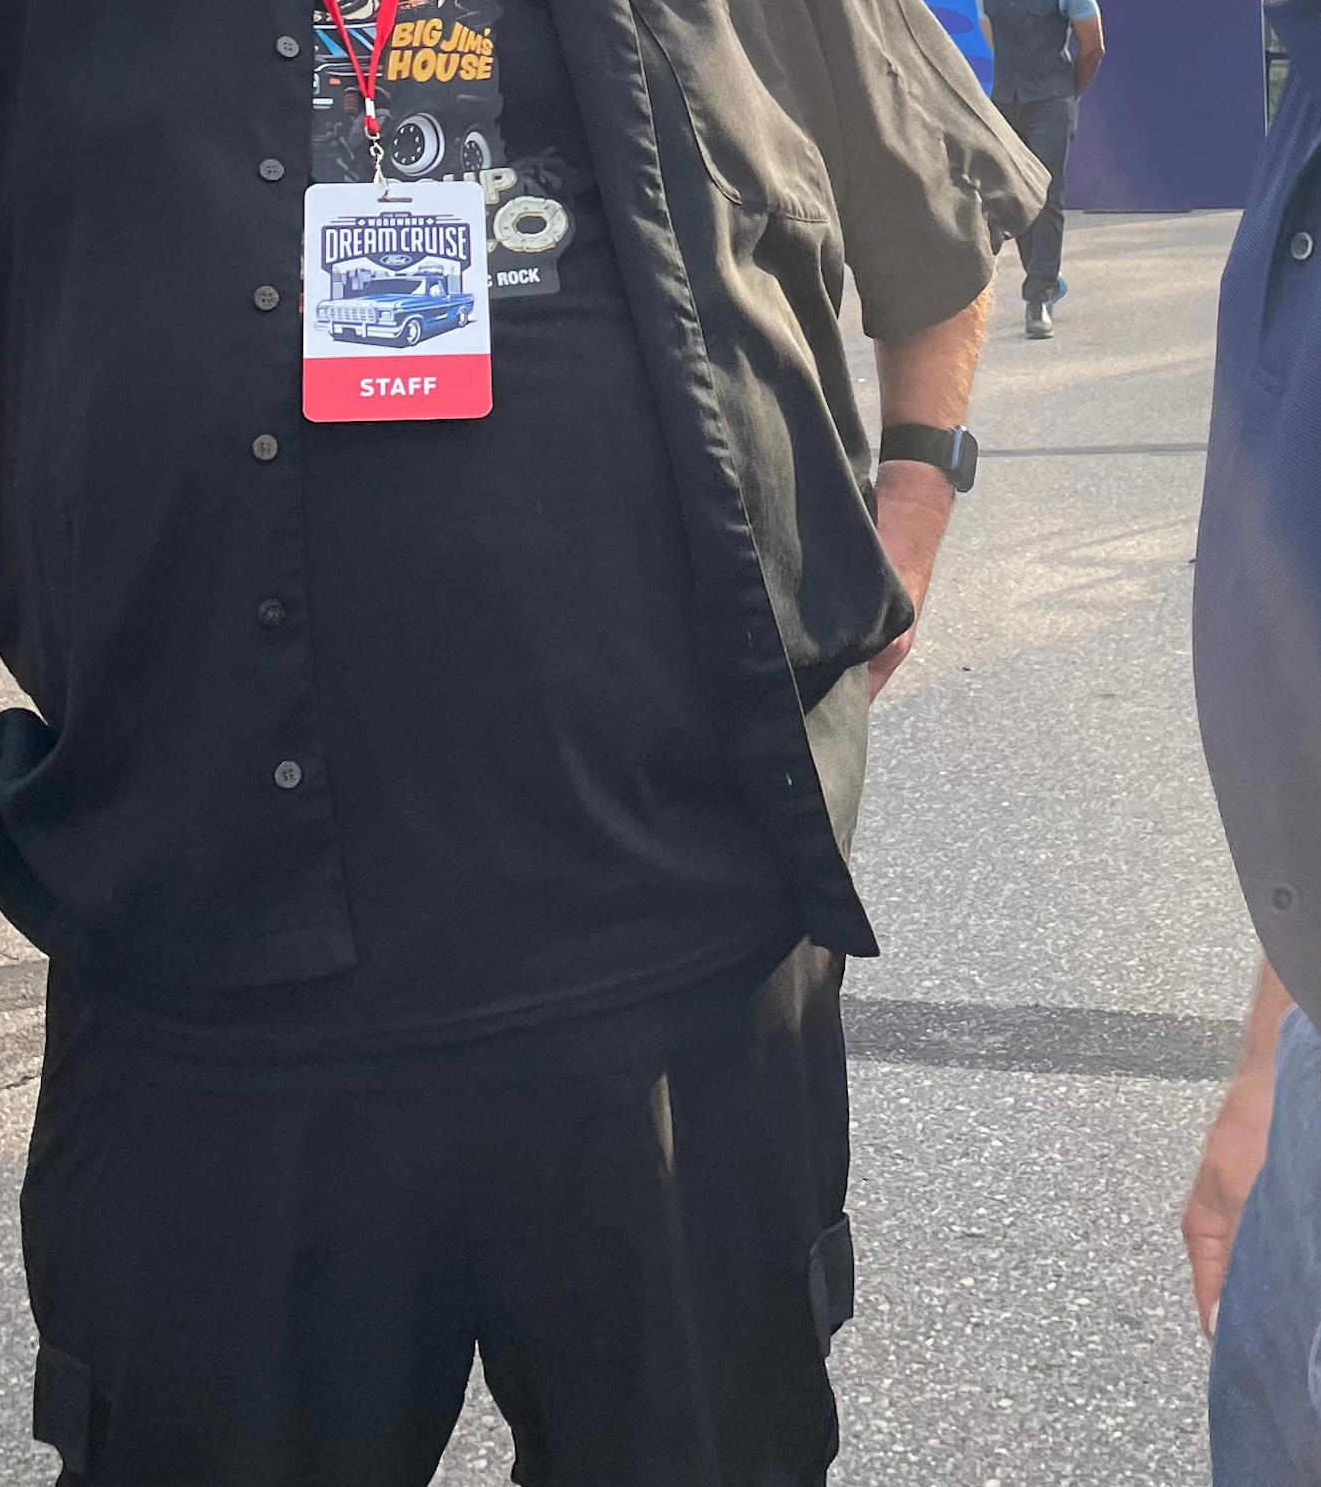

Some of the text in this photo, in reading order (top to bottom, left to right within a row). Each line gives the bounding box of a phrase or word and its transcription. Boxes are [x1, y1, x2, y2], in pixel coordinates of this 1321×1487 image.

[391, 18, 494, 56] BIG JIM'S
[386, 48, 494, 83] HOUSE
[497, 267, 542, 287] ROCK
[359, 376, 438, 398] STAFF
